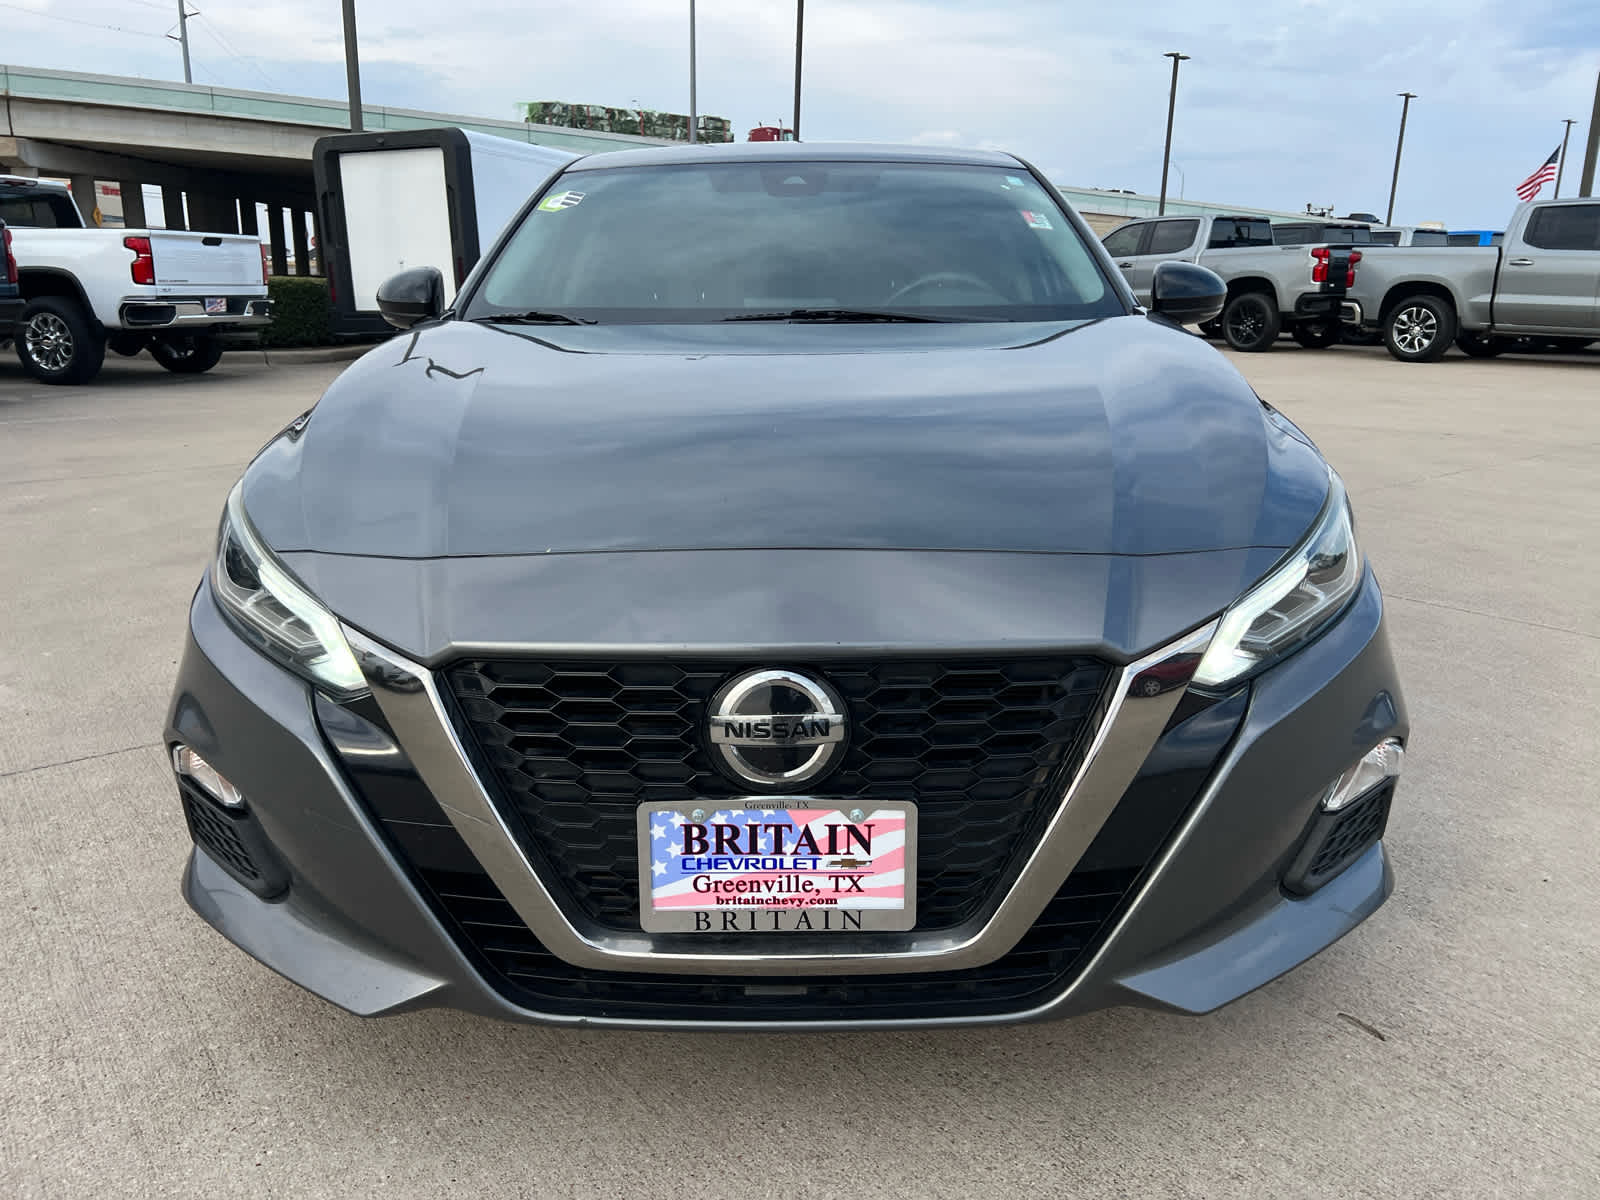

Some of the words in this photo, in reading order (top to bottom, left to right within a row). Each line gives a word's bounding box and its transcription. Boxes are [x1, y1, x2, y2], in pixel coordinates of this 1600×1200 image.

[724, 721, 830, 738] NISSAN
[795, 801, 809, 809] TX
[680, 823, 875, 856] BRITAIN
[681, 857, 822, 870] CHEVROLET
[692, 874, 821, 896] Greenville,
[828, 875, 865, 893] TX
[716, 896, 838, 907] britainchevy.com
[694, 910, 863, 931] BRITAIN
